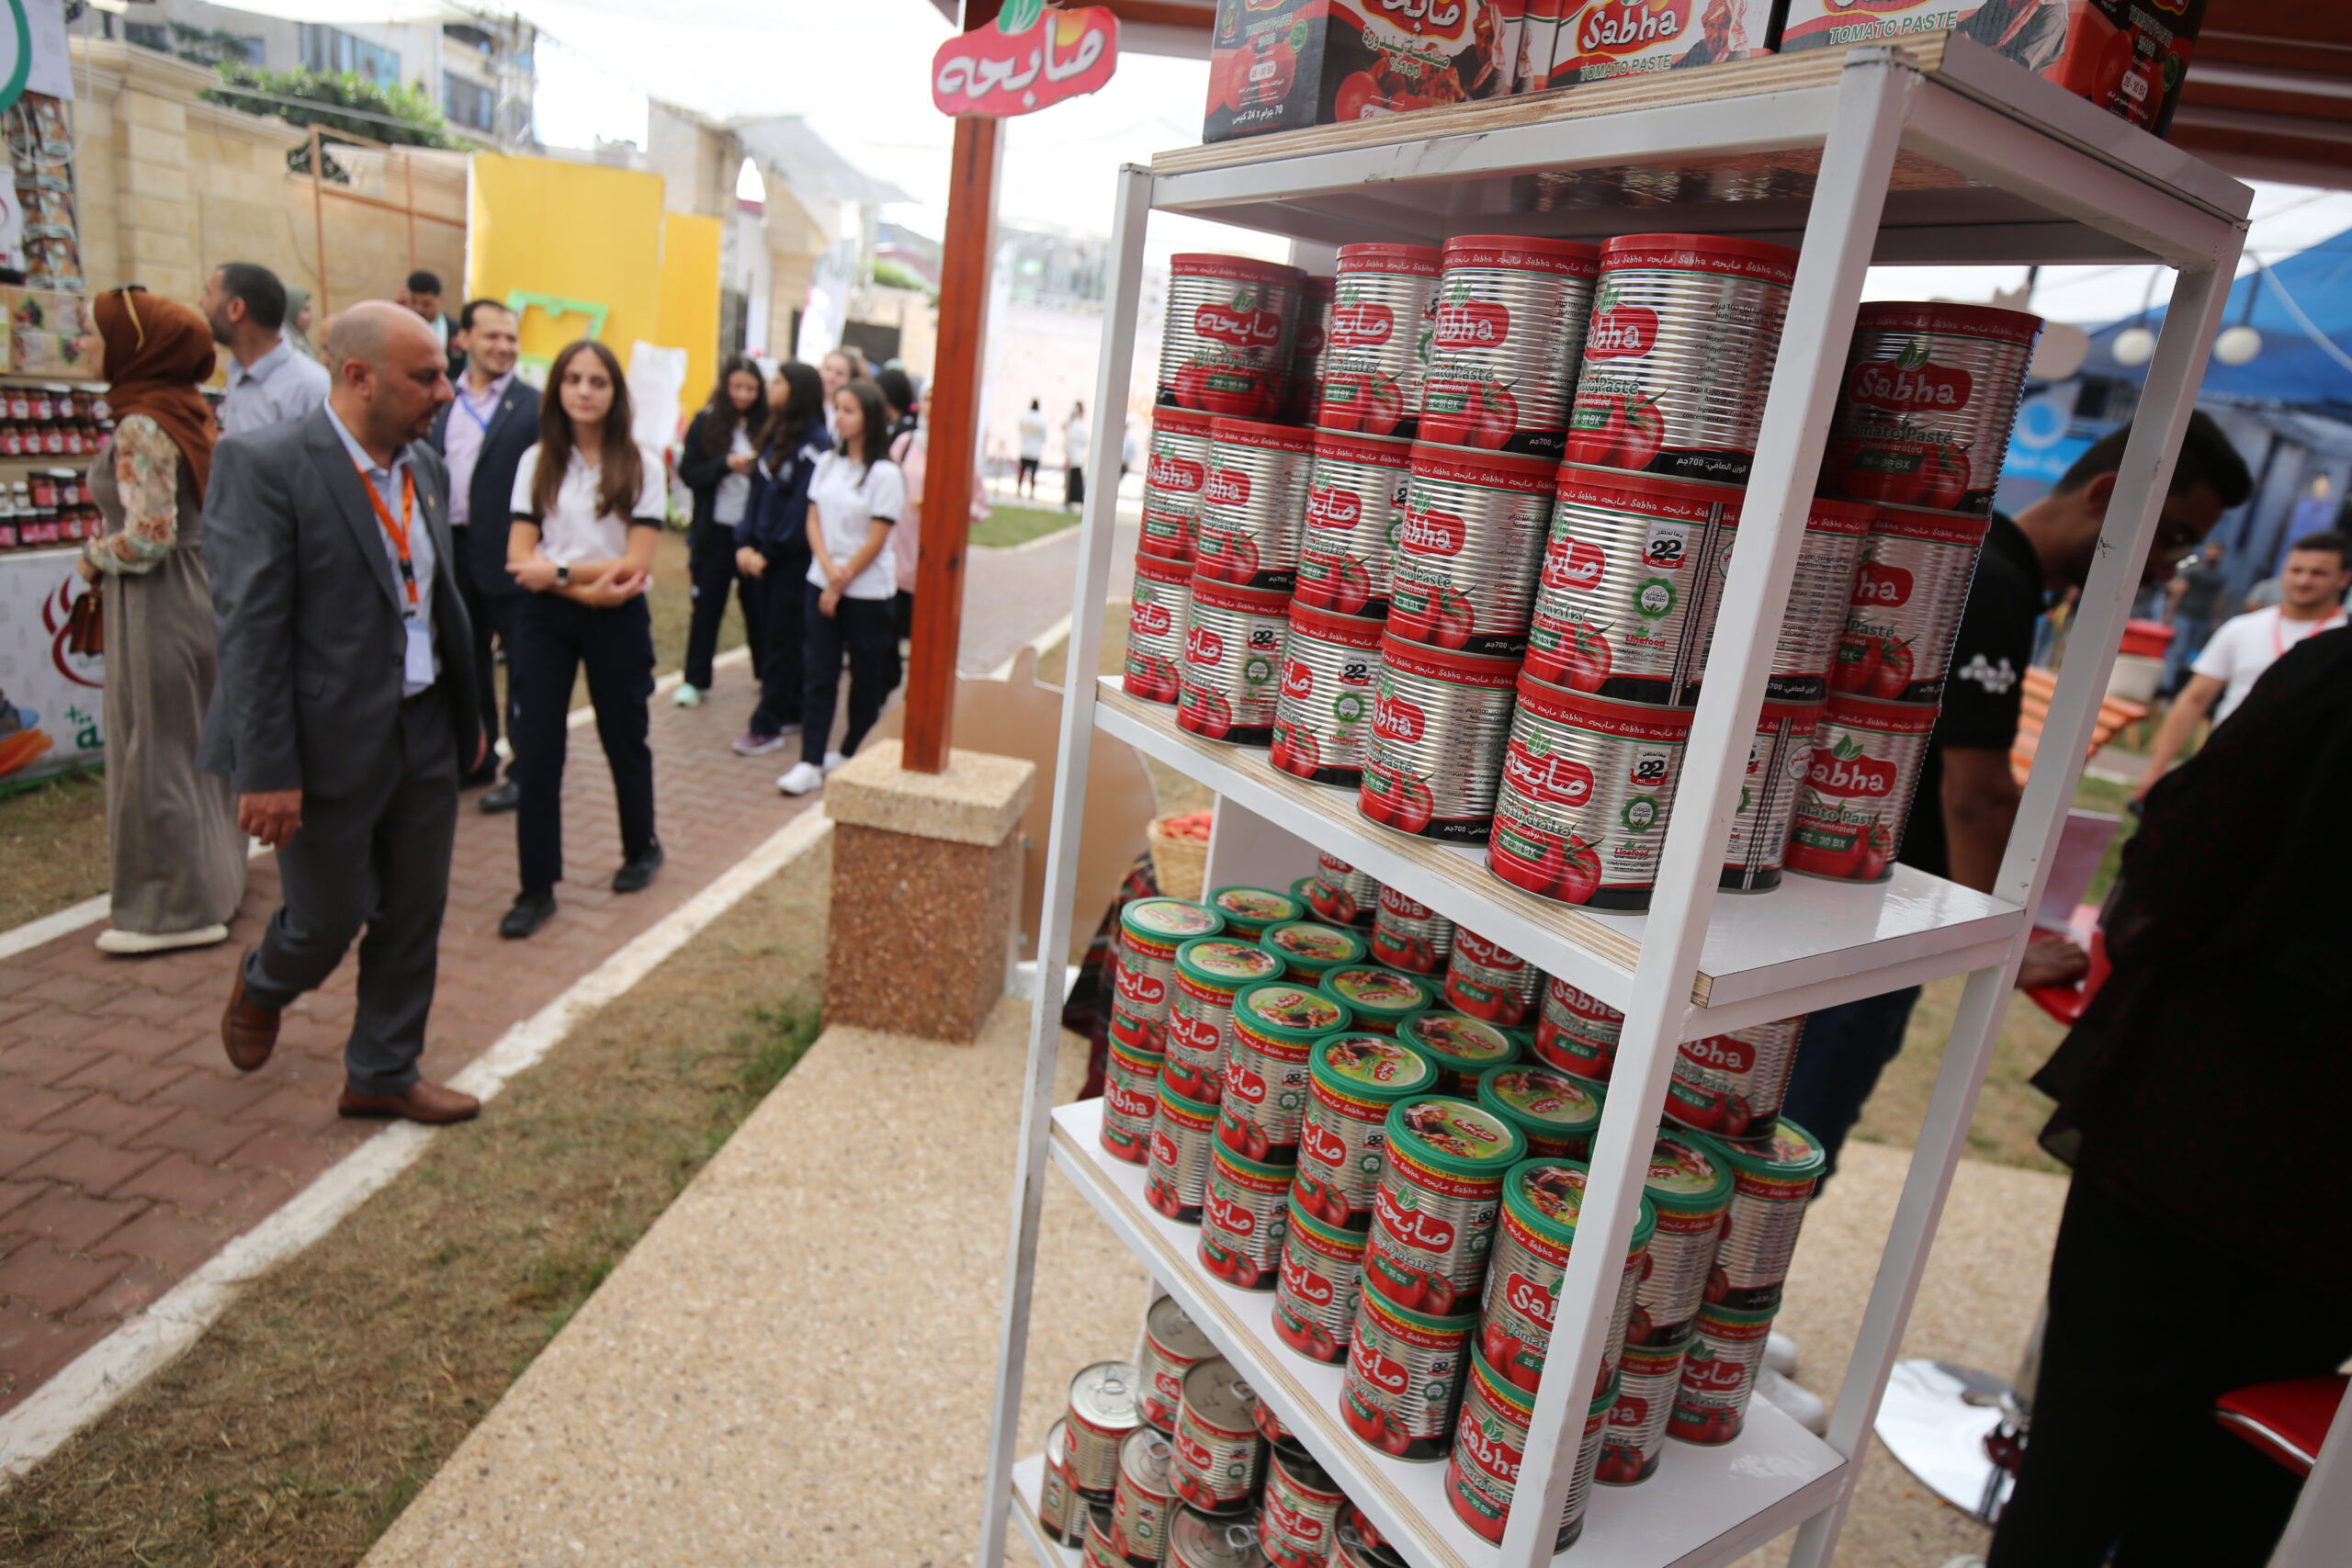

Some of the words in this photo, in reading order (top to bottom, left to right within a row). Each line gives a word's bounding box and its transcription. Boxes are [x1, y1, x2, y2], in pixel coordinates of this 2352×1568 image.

[1582, 7, 1679, 50] Sabha
[1828, 18, 1898, 45] TOMATO
[1902, 10, 1959, 33] PASTE
[1580, 60, 1630, 82] TOMATO
[1632, 54, 1672, 73] PASTE
[1248, 110, 1255, 120] 24
[1275, 105, 1283, 114] 70
[1473, 254, 1493, 264] Sabha
[1497, 257, 1521, 265] صابحه
[1525, 257, 1550, 268] Sabha
[1623, 254, 1643, 264] Sabha
[1647, 256, 1674, 265] صابحه
[1678, 254, 1706, 265] Sabha
[1713, 260, 1741, 270] صابحه
[1746, 263, 1771, 275] Sabha
[1197, 311, 1278, 343] صابحه
[1454, 367, 1494, 383] Paste
[1600, 376, 1639, 396] Paste
[1857, 367, 1957, 404] Sabha
[1906, 424, 1953, 446] Paste
[1896, 459, 1911, 470] BX
[1432, 467, 1450, 476] Sabha
[1481, 474, 1504, 484] Sabha
[1577, 491, 1597, 502] Sabha
[1601, 497, 1626, 506] صابحه
[1631, 499, 1657, 510] Sabha
[1663, 506, 1690, 515] صابحه
[1650, 540, 1681, 559] 22
[1252, 630, 1273, 644] 22
[1849, 621, 1895, 639] Paste
[1625, 634, 1666, 647] Linefood
[1344, 664, 1367, 679] 22
[1439, 669, 1461, 680] Sabha
[1538, 705, 1557, 716] صابحه
[1560, 711, 1583, 724] Sabha
[1589, 719, 1615, 729] صابحه
[1619, 723, 1645, 735] Sabha
[1637, 760, 1665, 779] 22
[1812, 763, 1886, 792] abha
[1797, 803, 1838, 822] mato
[1842, 812, 1881, 827] Paste
[1524, 845, 1536, 858] BX
[1614, 848, 1649, 857] Linefood
[1832, 837, 1847, 849] BX
[1367, 1134, 1384, 1145] 22
[1423, 1177, 1450, 1190] صابحه
[1529, 1239, 1554, 1258] Sabha
[1513, 1284, 1557, 1324] Sab
[1507, 1320, 1549, 1351] Tomat
[1486, 1483, 1513, 1505] Past
